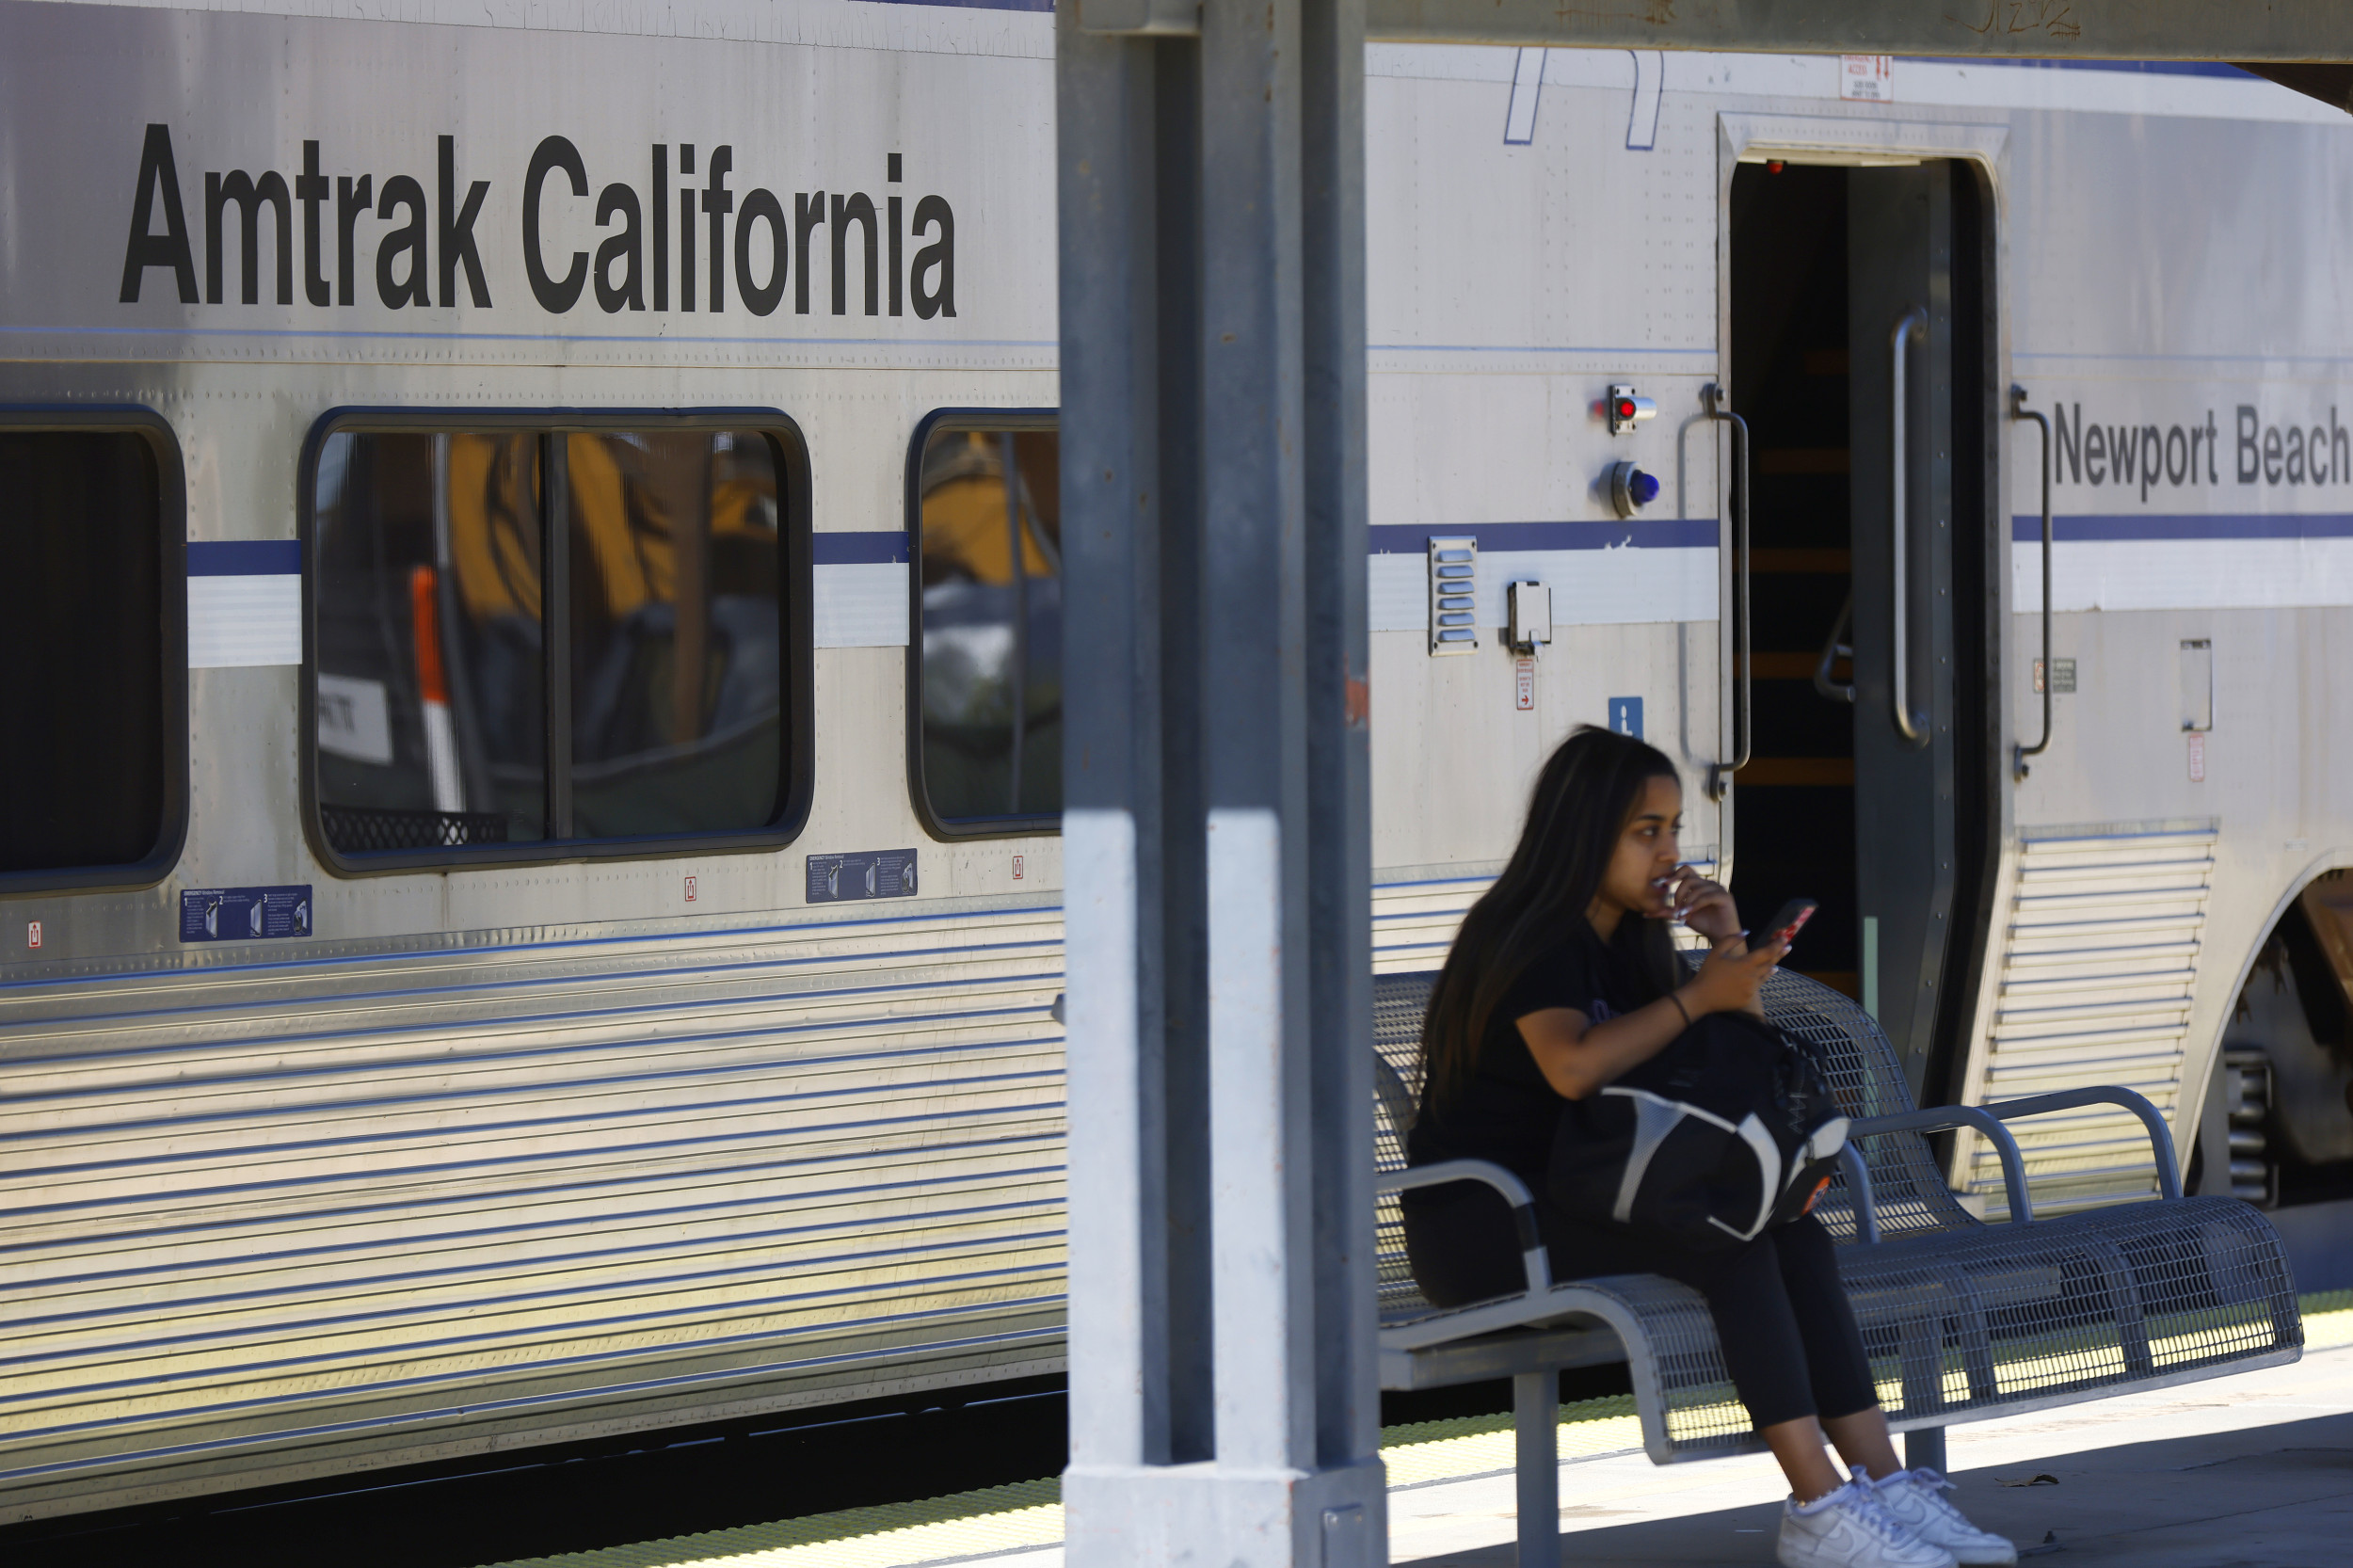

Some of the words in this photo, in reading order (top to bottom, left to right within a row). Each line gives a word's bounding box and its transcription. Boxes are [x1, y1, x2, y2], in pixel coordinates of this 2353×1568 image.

[119, 123, 493, 309] Amtrak
[522, 135, 957, 320] California
[2055, 402, 2219, 504] Newport
[2236, 405, 2351, 487] Beach
